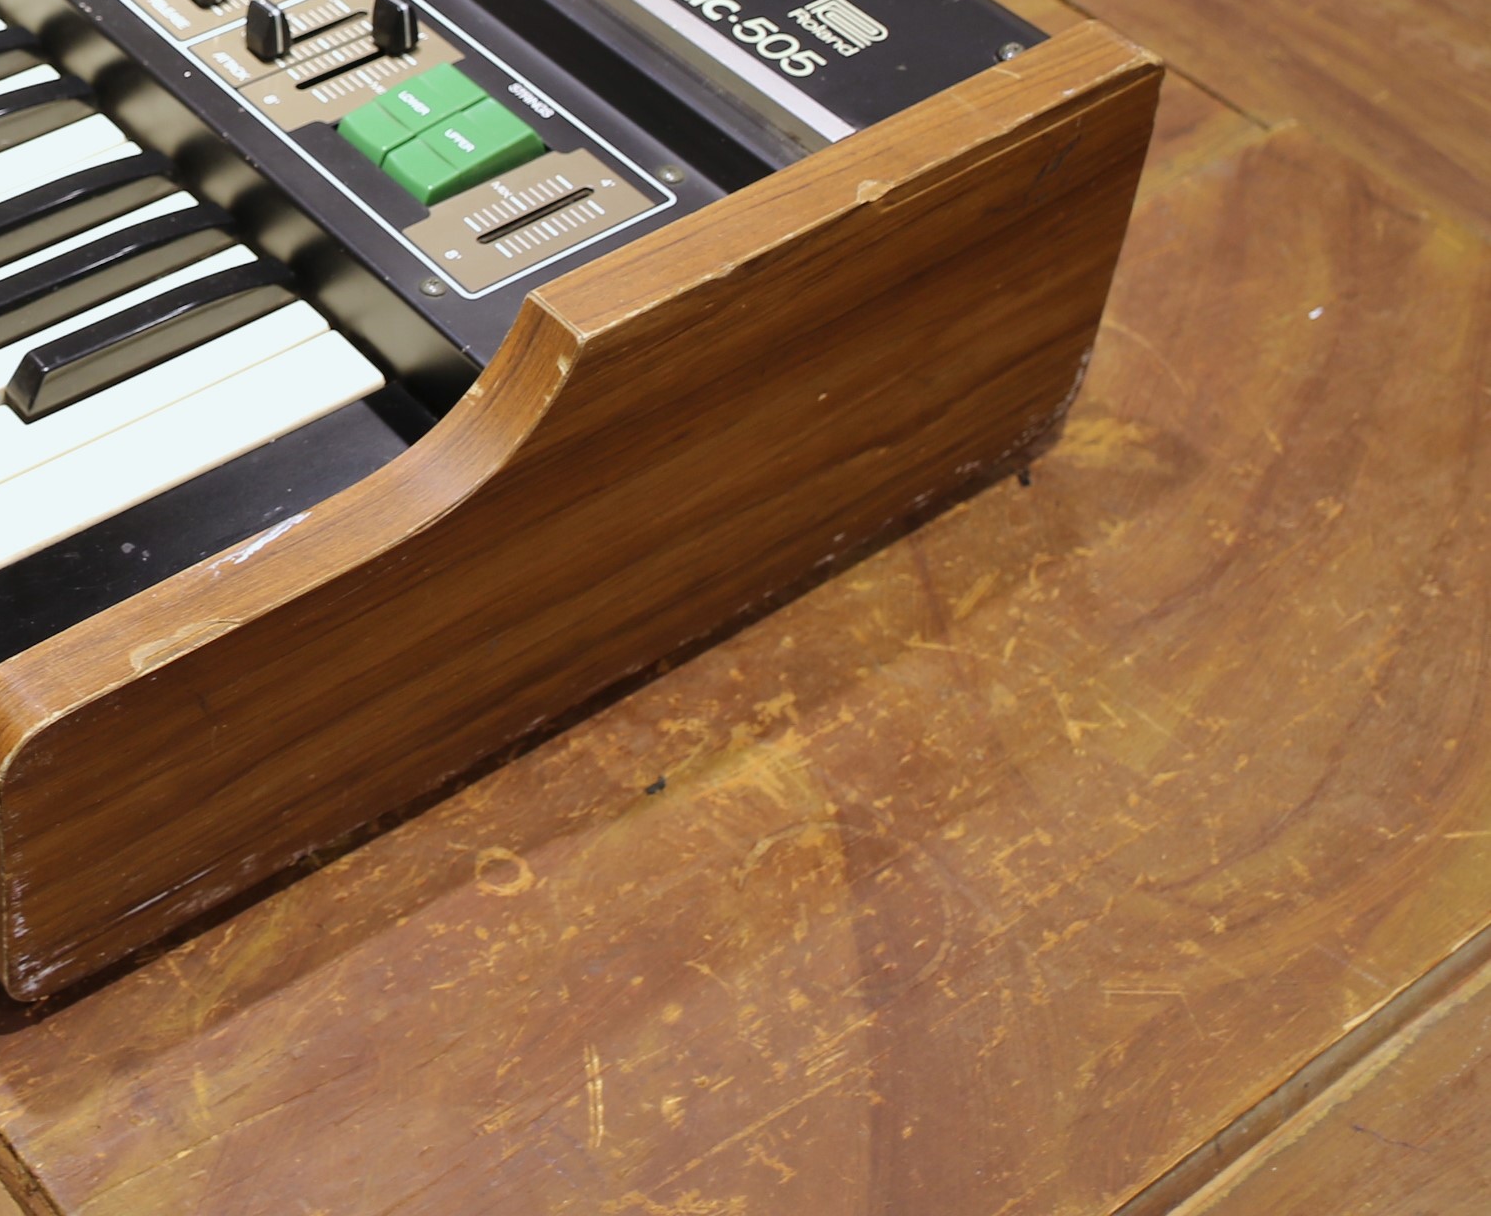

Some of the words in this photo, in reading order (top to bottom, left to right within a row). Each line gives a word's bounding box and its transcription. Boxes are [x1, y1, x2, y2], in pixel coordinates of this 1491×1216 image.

[787, 7, 860, 57] Roland
[398, 90, 431, 116] LOWER
[508, 82, 555, 118] STRINGS
[444, 128, 475, 153] UPPER
